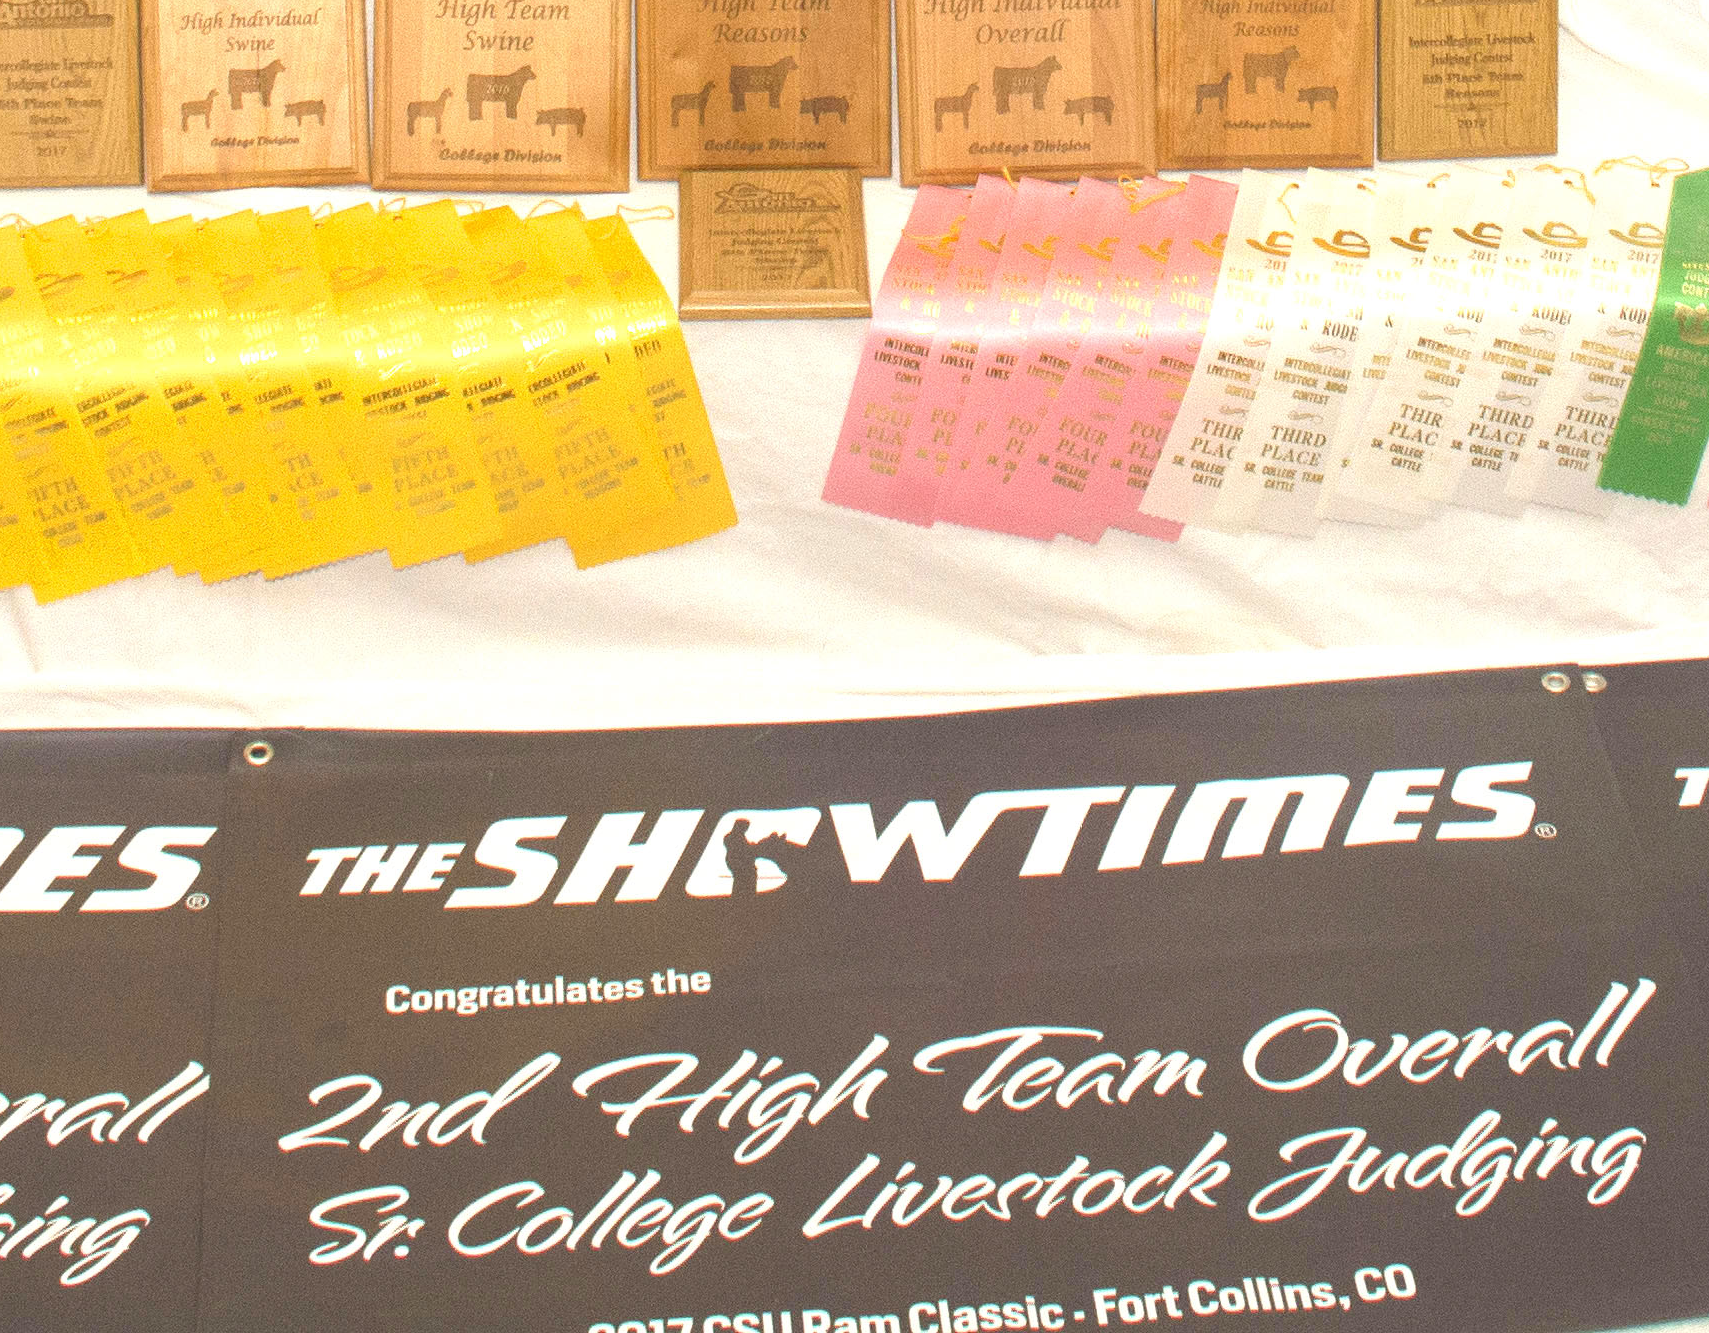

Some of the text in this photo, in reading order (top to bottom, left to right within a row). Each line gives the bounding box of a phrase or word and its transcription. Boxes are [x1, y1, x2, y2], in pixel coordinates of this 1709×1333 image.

[462, 30, 534, 53] Swine
[713, 24, 809, 44] Reasons
[976, 20, 1065, 45] Overall
[1271, 425, 1327, 447] THIRD
[1260, 443, 1322, 467] PLACE
[298, 761, 1538, 909] THE SHOWTIMES
[385, 967, 711, 1014] Congratulates the
[278, 978, 1657, 1164] 2nd High Team Overall
[307, 1110, 1647, 1274] Sr. College Livestock Judging
[908, 1294, 1064, 1333] Classic
[1092, 1284, 1181, 1326] Fort
[1187, 1277, 1352, 1315] Collins,
[1355, 1264, 1418, 1301] CO
